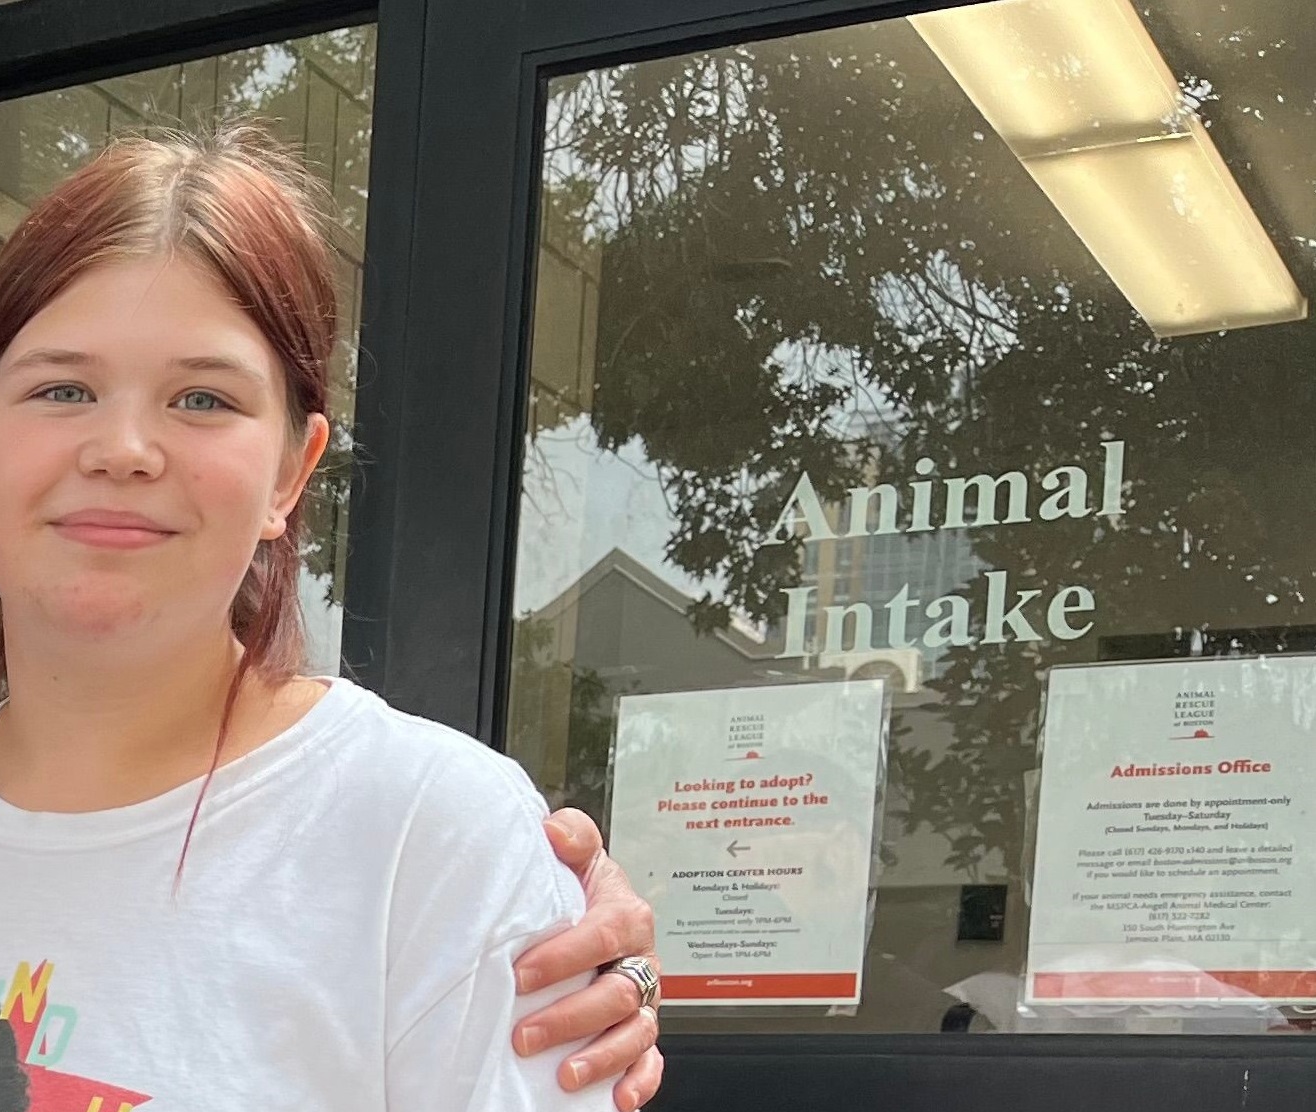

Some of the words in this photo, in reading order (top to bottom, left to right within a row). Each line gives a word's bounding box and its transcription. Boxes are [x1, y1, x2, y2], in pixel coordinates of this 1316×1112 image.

[763, 440, 1127, 546] Animal
[774, 570, 1095, 660] Intake
[1176, 691, 1215, 699] ANIMAL
[1175, 701, 1215, 709] RESCUE
[731, 715, 764, 723] ANIMAL
[1175, 710, 1214, 719] LEAGUE
[730, 724, 764, 732] RESCUE
[729, 733, 764, 741] LEAGUE
[1111, 763, 1212, 778] Admissions
[1218, 759, 1271, 773] Office
[674, 779, 734, 793] Looking
[740, 779, 754, 789] to
[760, 774, 812, 790] adopt?
[658, 800, 706, 812] Please
[711, 796, 777, 810] continue
[783, 795, 798, 806] to
[803, 792, 828, 805] the
[1087, 801, 1142, 810] Admissions
[1164, 799, 1187, 807] done
[1191, 799, 1201, 808] by
[1205, 796, 1291, 808] appointment-only
[686, 818, 719, 829] next
[724, 816, 795, 827] entrance.
[672, 870, 724, 878] ADOPTION
[727, 869, 764, 877] CENTER
[768, 867, 803, 876] HOURS
[693, 884, 729, 892] Mondays
